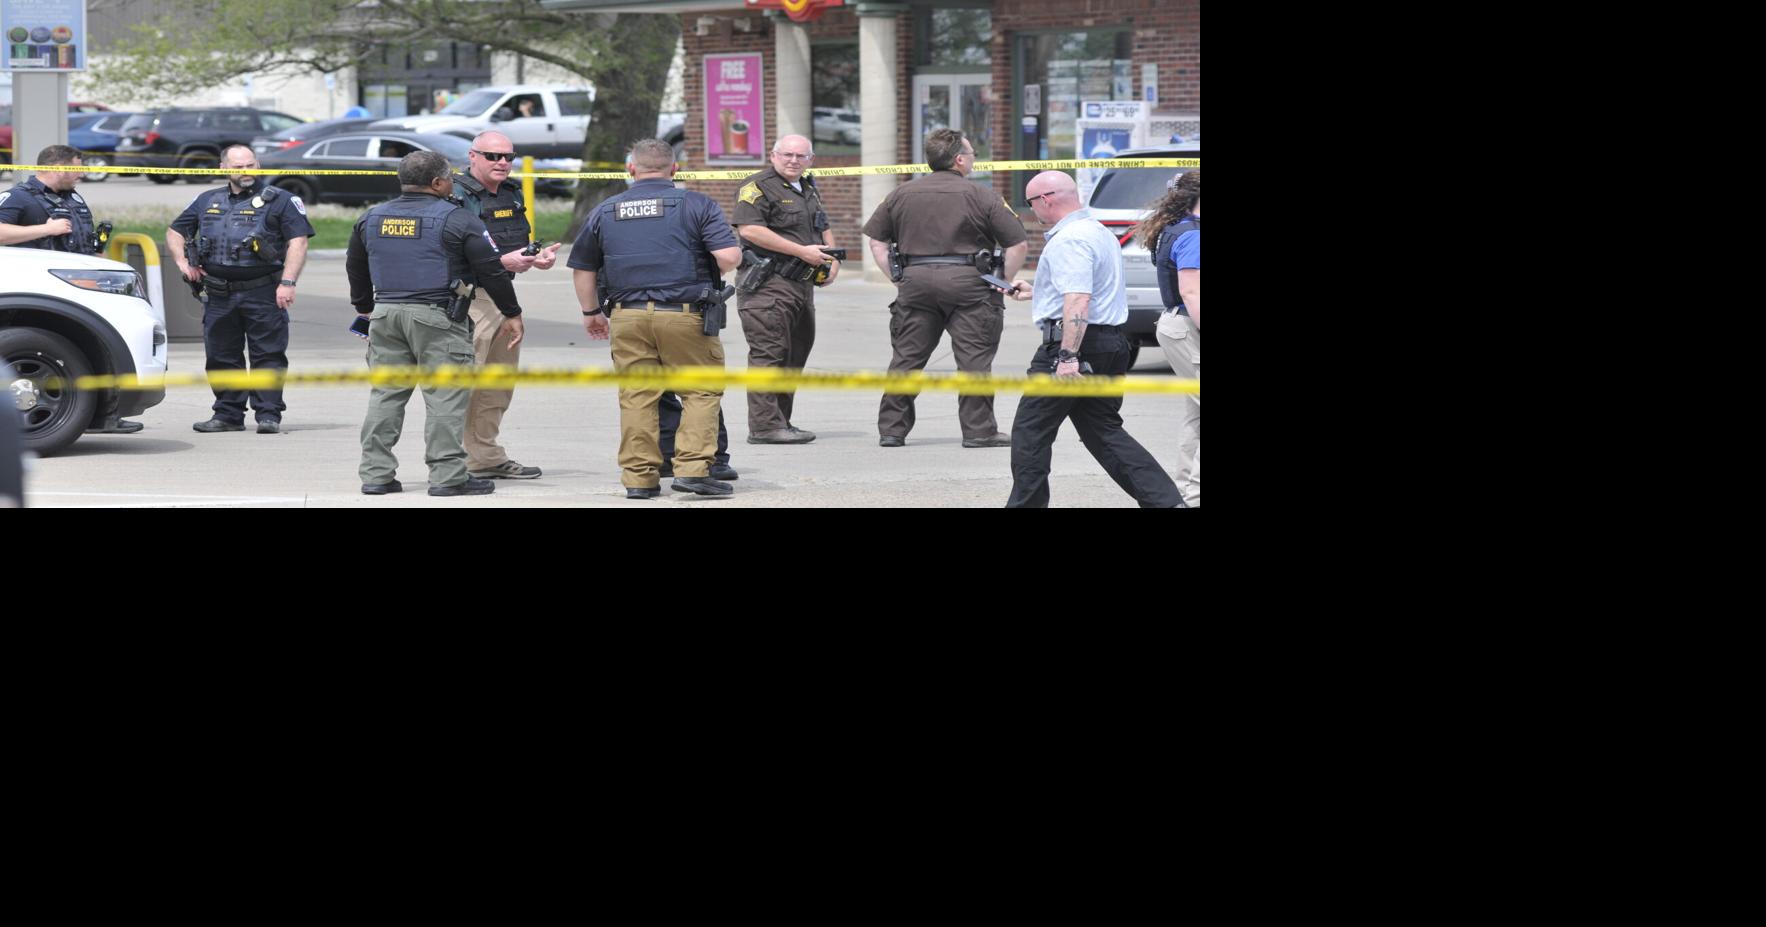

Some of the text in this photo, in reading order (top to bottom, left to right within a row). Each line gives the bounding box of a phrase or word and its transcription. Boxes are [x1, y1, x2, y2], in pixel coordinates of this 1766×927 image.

[720, 60, 747, 80] FREE
[1056, 161, 1072, 169] NOT
[1117, 160, 1145, 168] CRIME
[620, 199, 657, 208] ANDERSON
[494, 209, 513, 218] SHERIFF
[620, 206, 658, 218] POLICE
[383, 218, 416, 226] ANDERSON
[381, 225, 415, 236] POLICE
